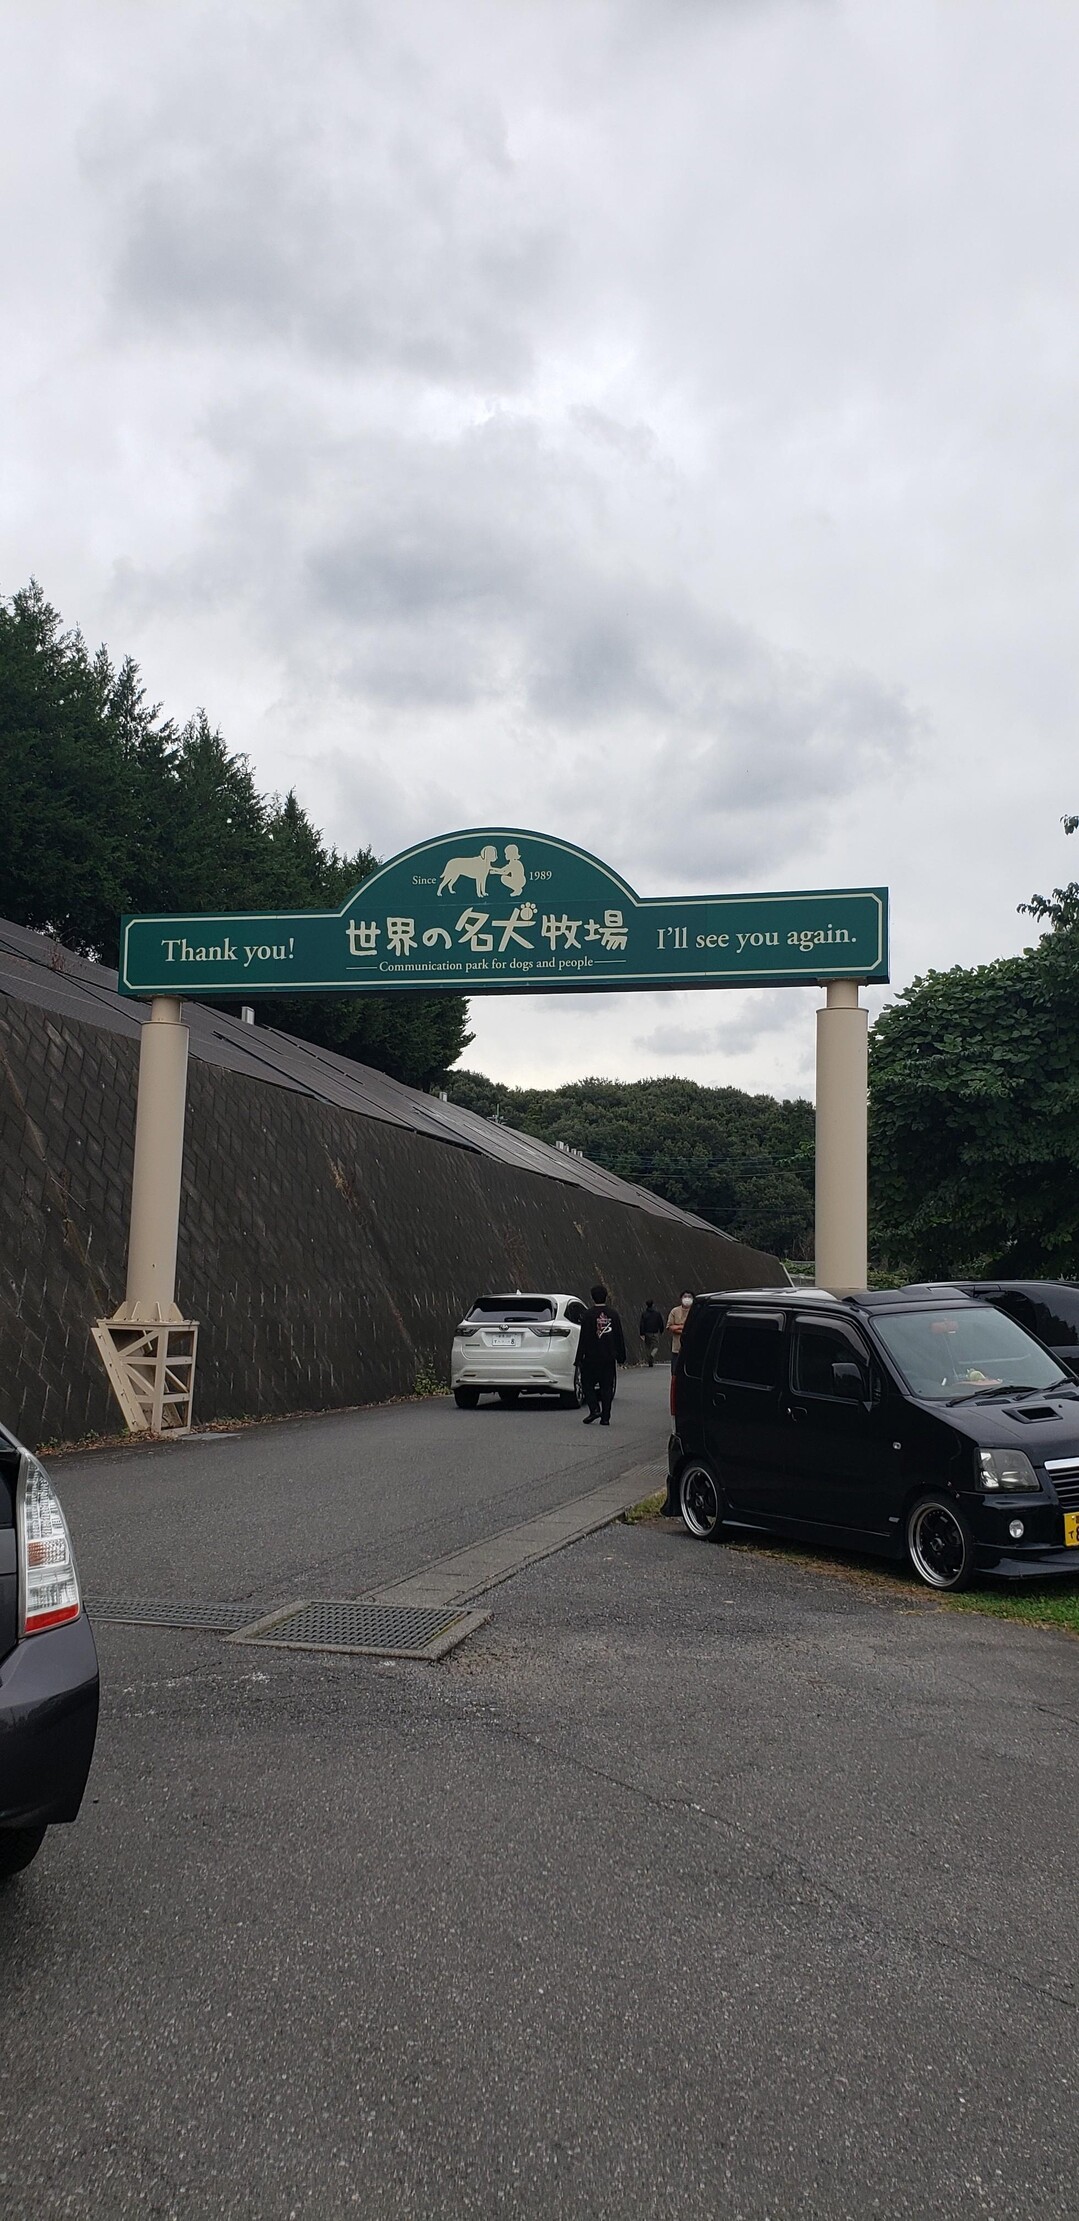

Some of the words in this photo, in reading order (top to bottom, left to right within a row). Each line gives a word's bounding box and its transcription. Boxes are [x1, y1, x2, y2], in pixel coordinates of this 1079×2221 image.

[412, 875, 437, 885] Since
[529, 870, 552, 881] 1989
[346, 902, 628, 956] 世界の名犬牧場
[656, 926, 688, 950] I'll
[695, 933, 730, 949] see
[735, 932, 780, 954] you
[787, 923, 857, 952] again.
[160, 937, 238, 962] Thank
[243, 937, 294, 967] you!
[379, 960, 462, 972] Communication
[465, 958, 489, 973] park
[491, 957, 507, 969] for
[509, 957, 534, 972] dogs
[536, 956, 556, 968] and
[558, 955, 594, 971] people
